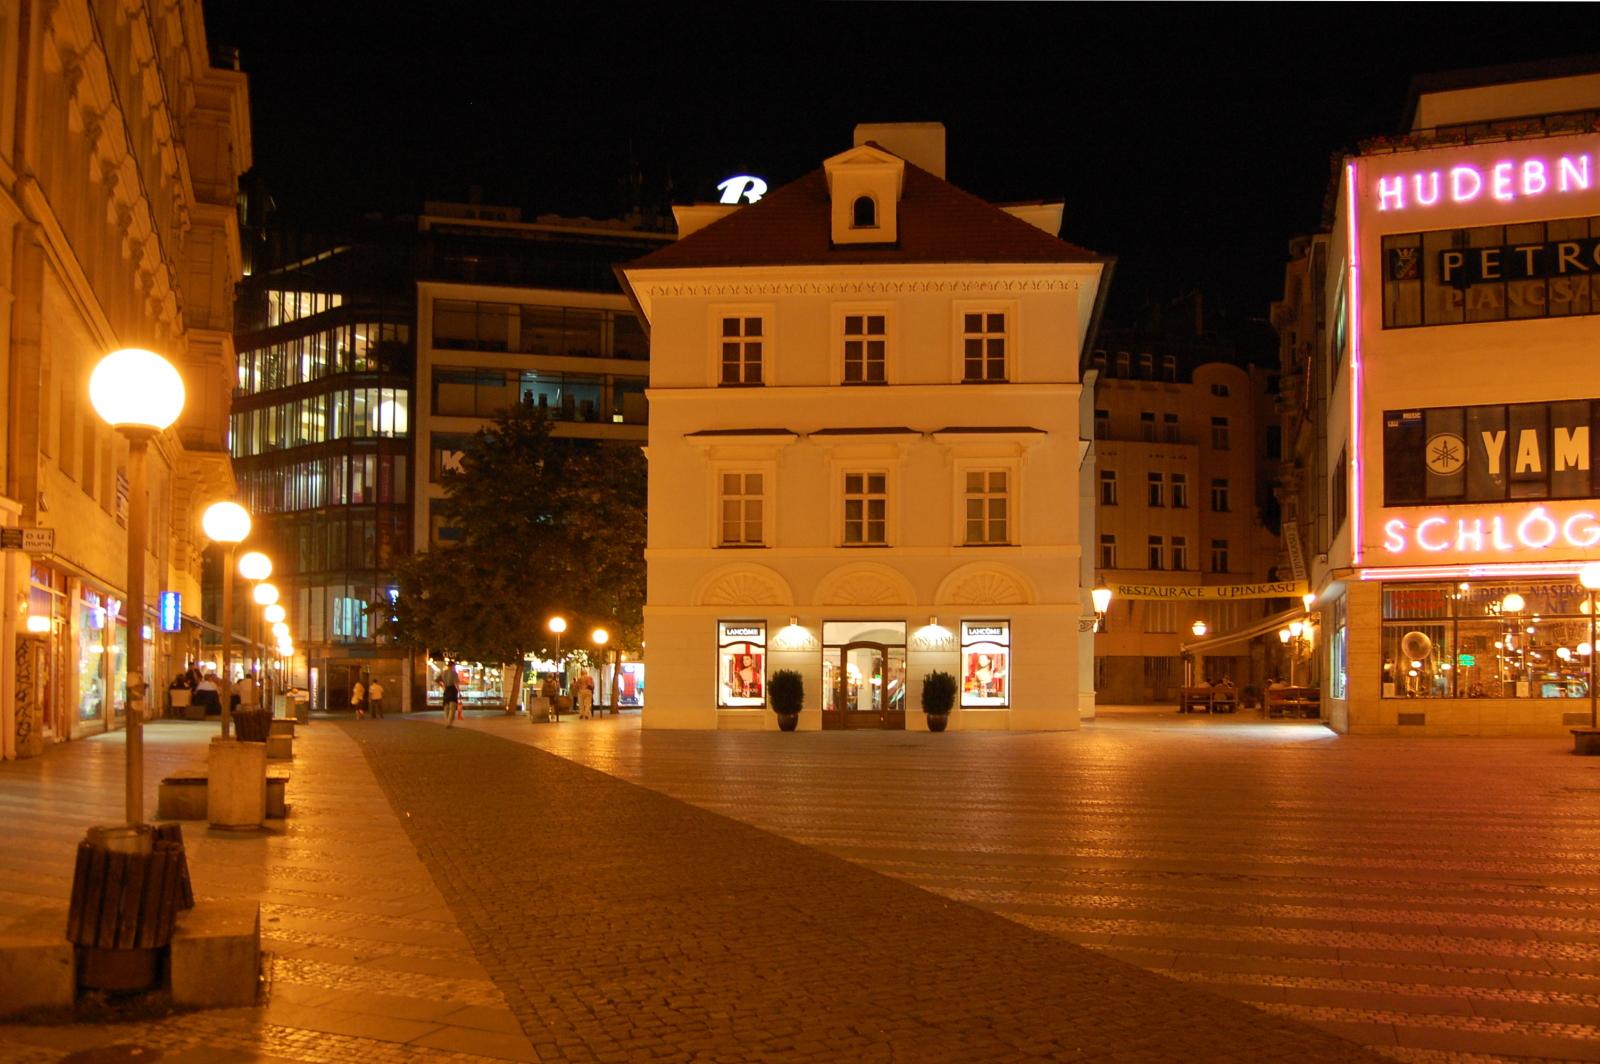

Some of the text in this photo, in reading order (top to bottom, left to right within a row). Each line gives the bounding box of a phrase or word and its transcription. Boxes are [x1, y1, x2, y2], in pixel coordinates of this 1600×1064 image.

[1379, 155, 1592, 211] HUDEBN
[1481, 426, 1590, 475] YAM
[1118, 584, 1205, 598] RESTAURACE
[1217, 588, 1228, 598] U
